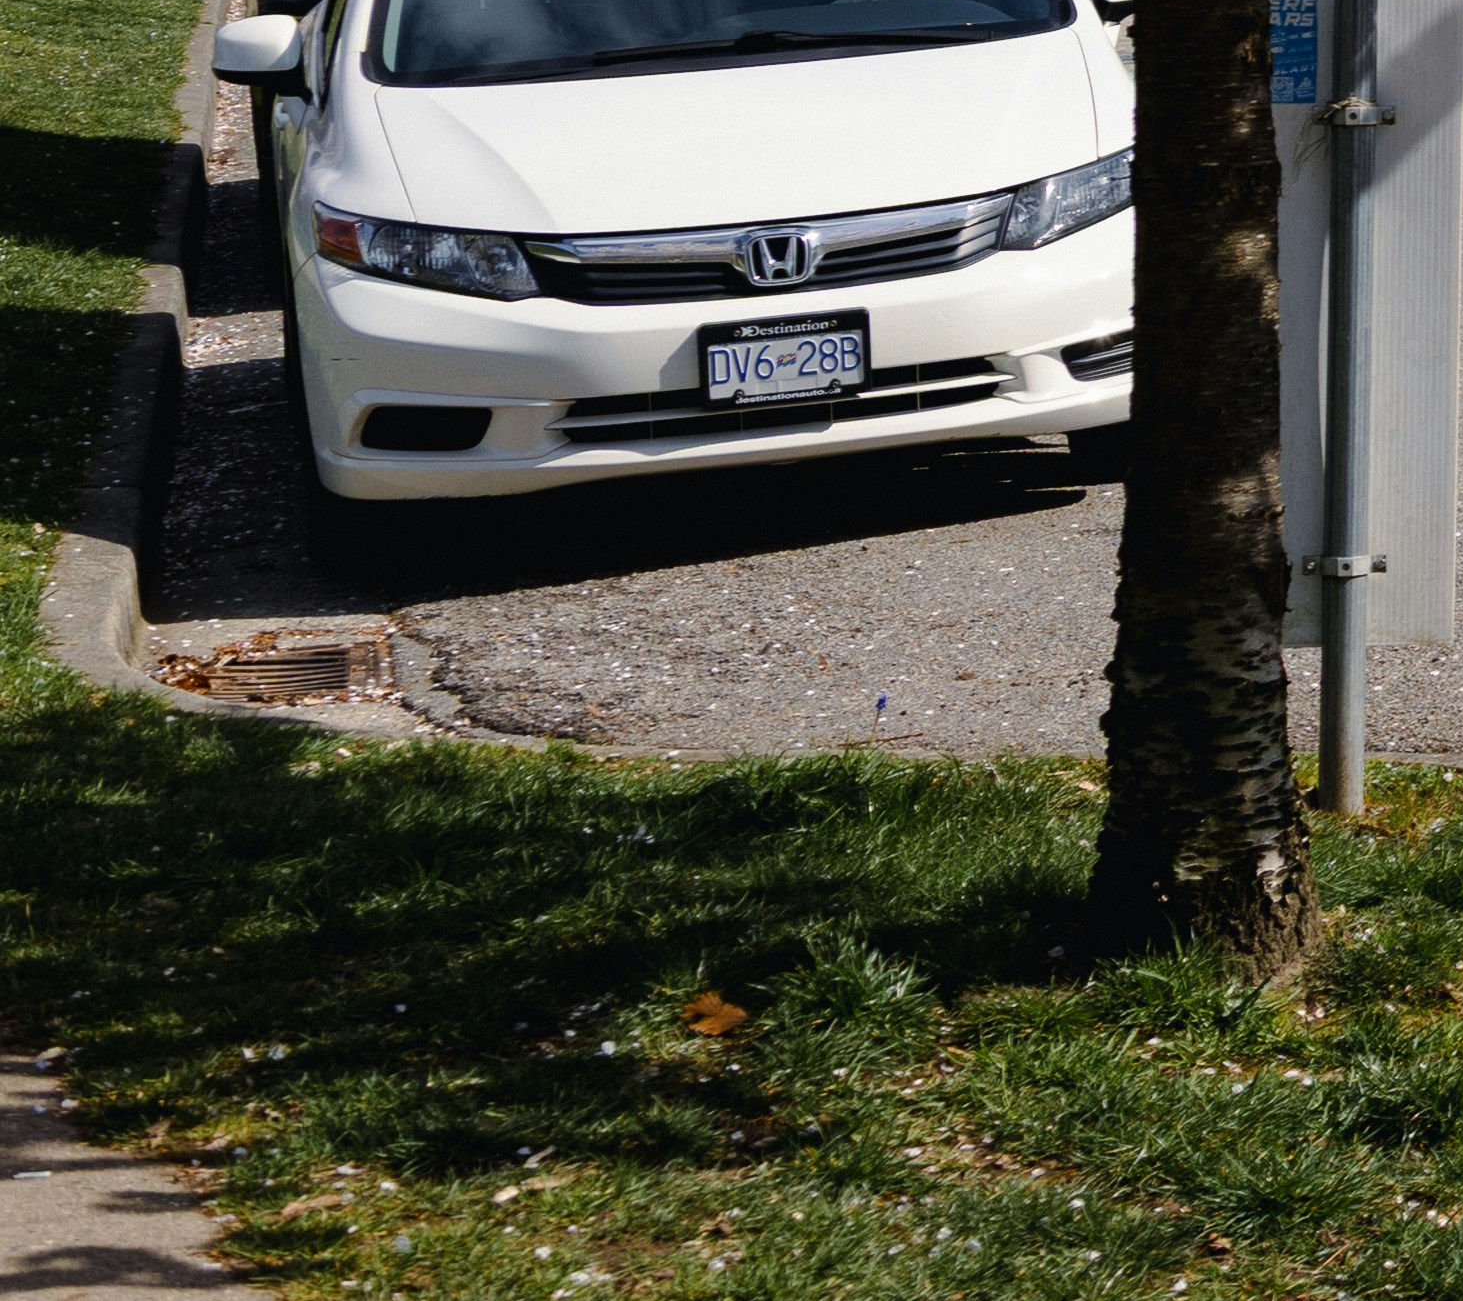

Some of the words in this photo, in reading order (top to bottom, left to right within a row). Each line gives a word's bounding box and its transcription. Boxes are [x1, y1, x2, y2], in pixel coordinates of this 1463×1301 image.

[1269, 12, 1316, 27] ARS
[741, 320, 829, 337] Destination
[709, 344, 775, 386] DV6
[797, 336, 862, 376] 28B
[735, 387, 842, 404] destinationauto.ca
